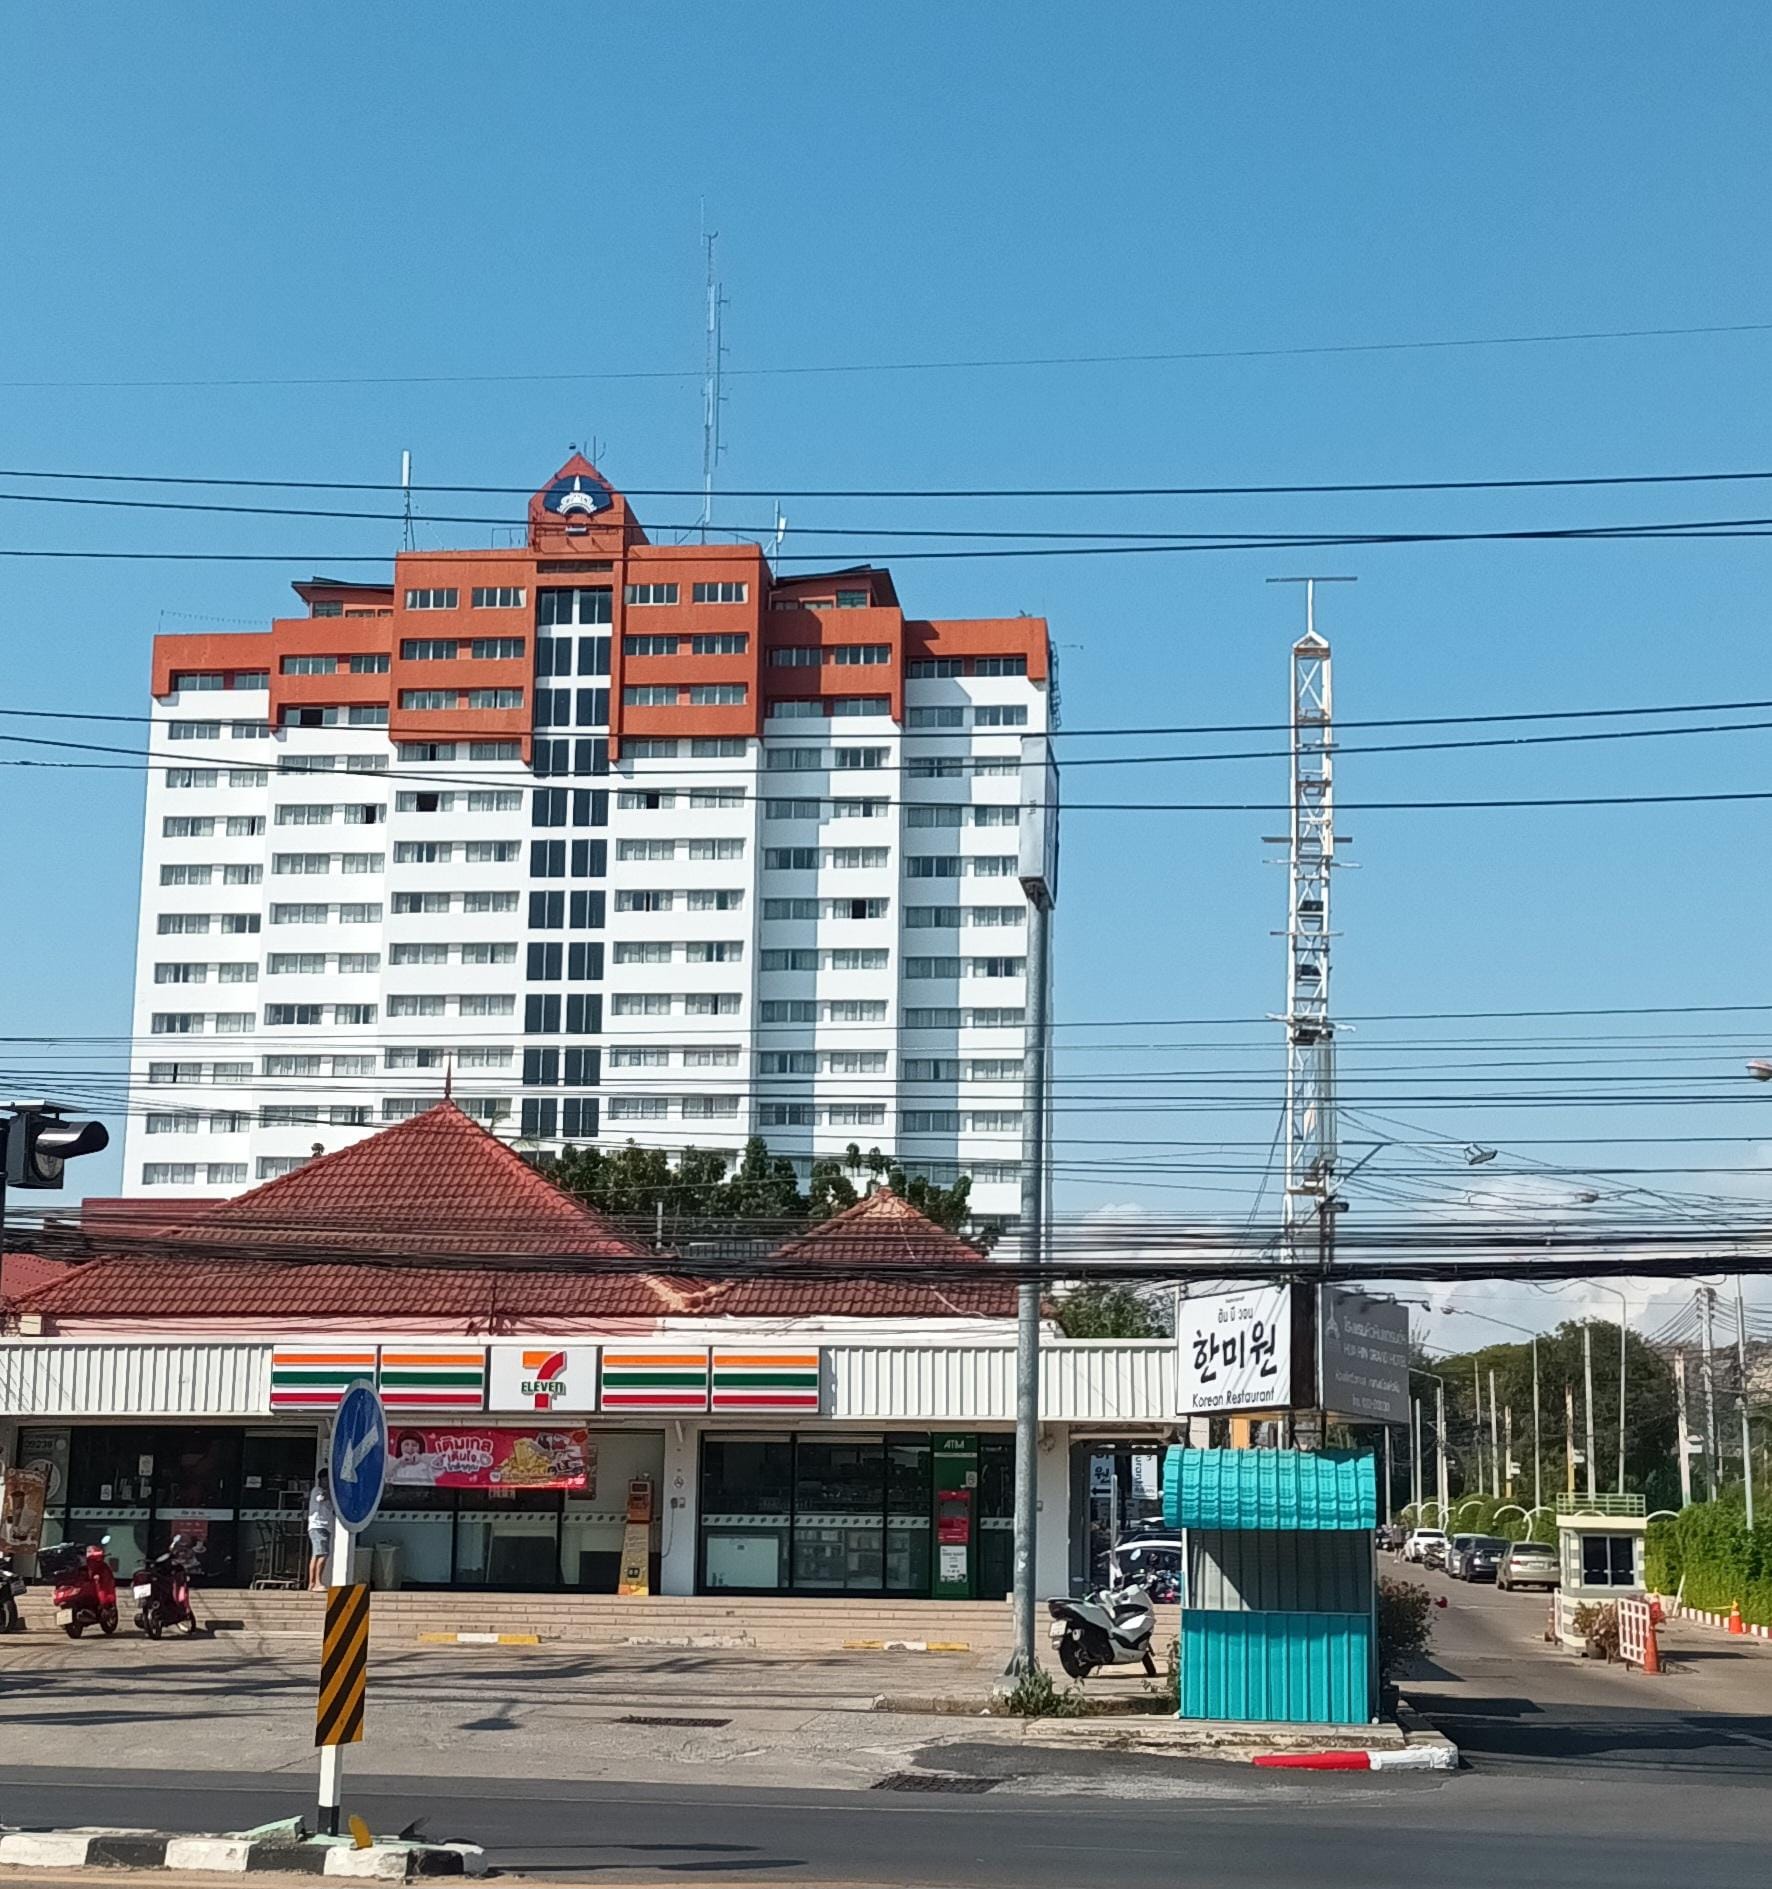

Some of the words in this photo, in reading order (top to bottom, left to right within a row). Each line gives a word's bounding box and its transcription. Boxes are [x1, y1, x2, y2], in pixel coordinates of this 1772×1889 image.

[1193, 1320, 1278, 1384] 한미원
[1192, 1392, 1224, 1407] Korean
[1225, 1386, 1274, 1405] Restaurant
[944, 1439, 965, 1449] ATM
